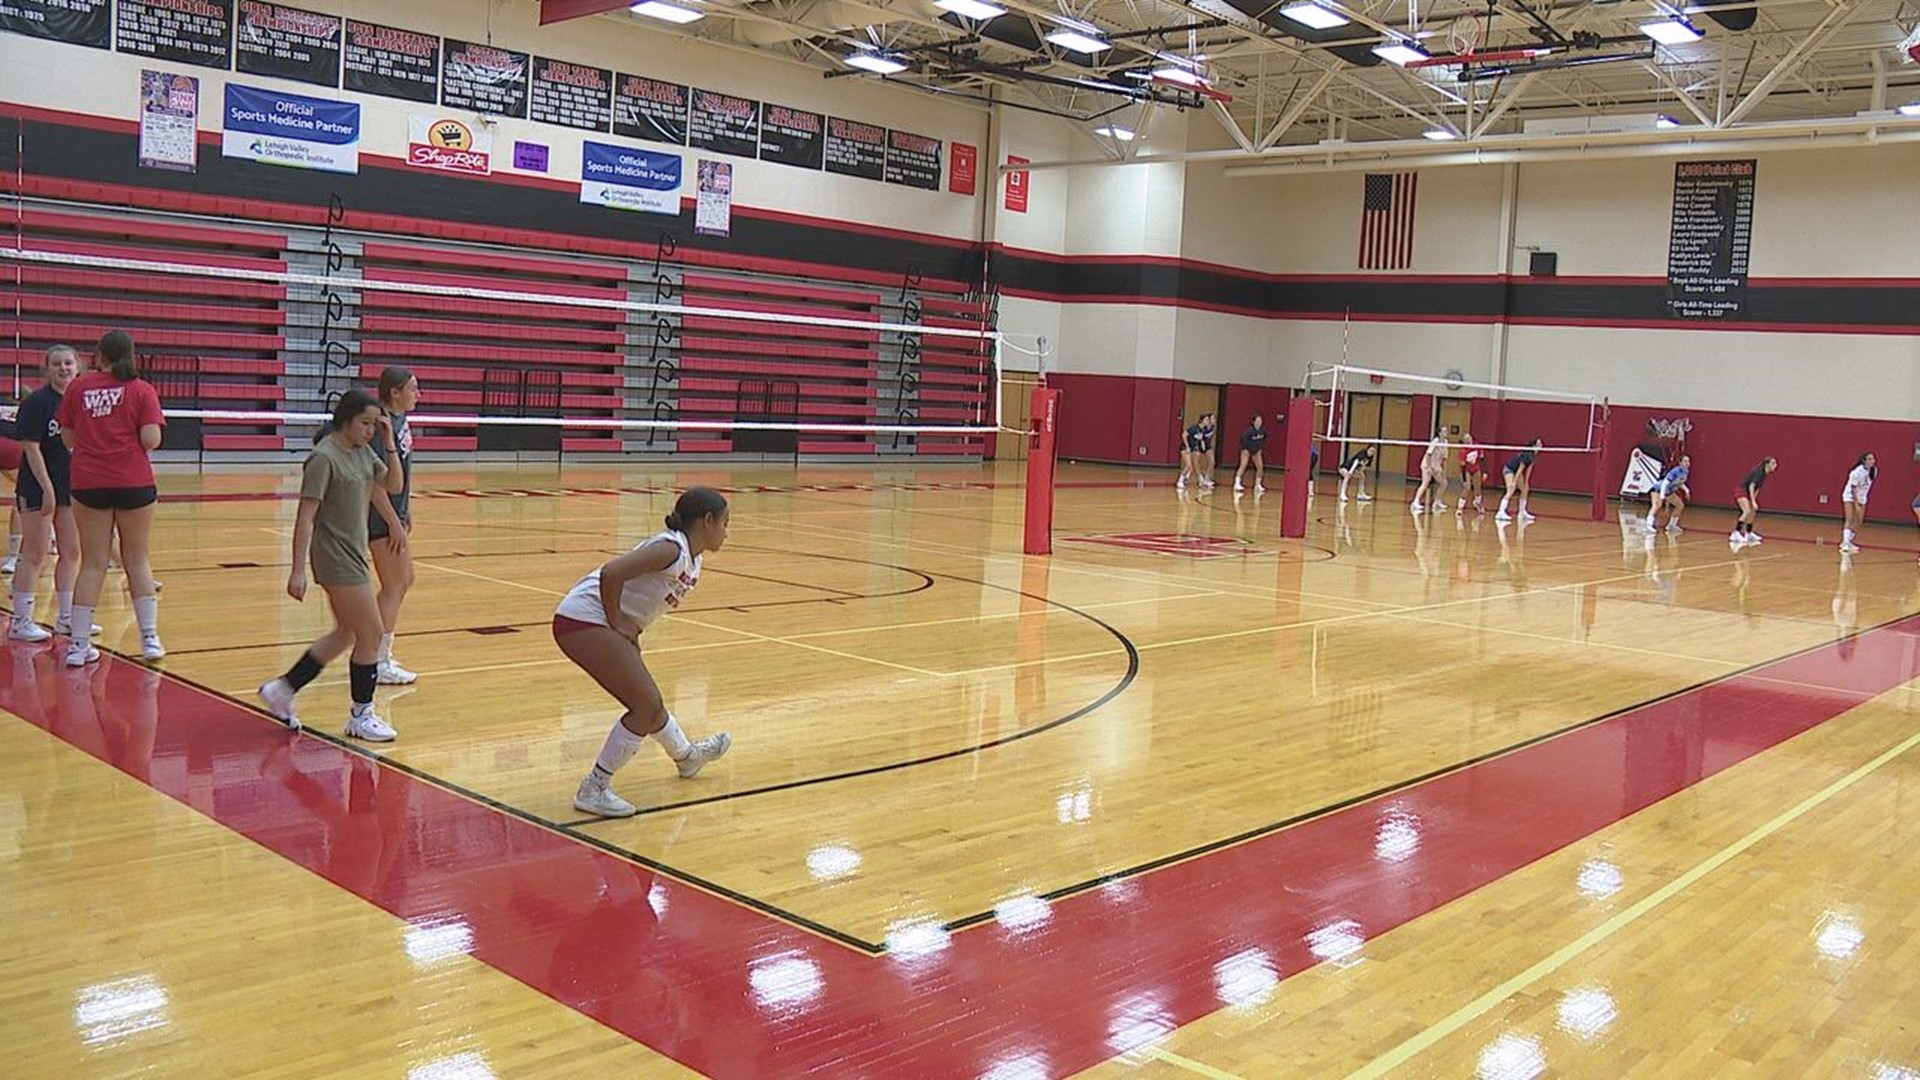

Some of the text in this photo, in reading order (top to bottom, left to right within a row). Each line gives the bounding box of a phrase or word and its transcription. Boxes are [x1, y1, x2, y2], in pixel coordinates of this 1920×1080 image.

[275, 101, 314, 116] Official
[231, 107, 354, 135] Sports Medicine Partner
[264, 141, 289, 152] Lehigh
[264, 149, 304, 161] Orthopedic
[412, 147, 486, 168] ShopRite
[618, 154, 647, 167] Official
[587, 161, 677, 182] Sports Medicine Partner
[1703, 164, 1730, 176] Point
[1714, 277, 1739, 286] Leading
[1713, 301, 1738, 310] Leading
[84, 391, 122, 410] WAY
